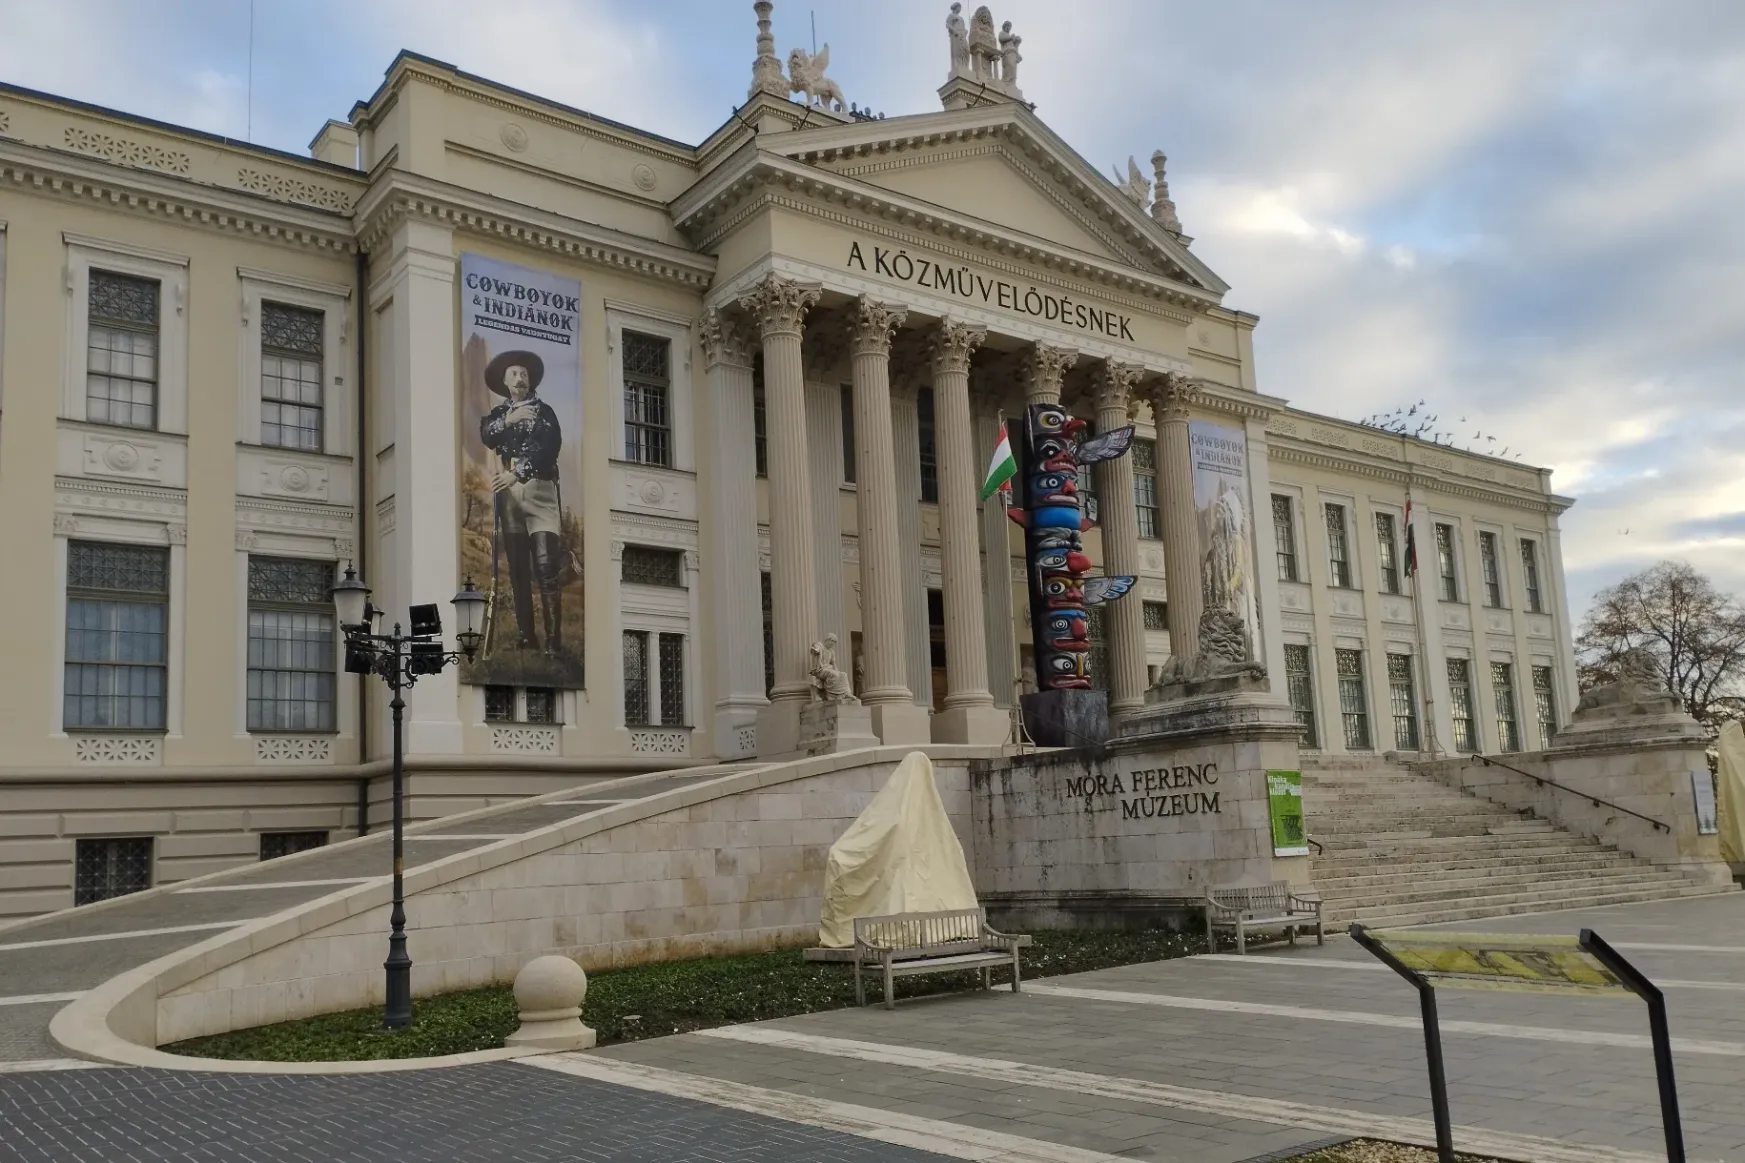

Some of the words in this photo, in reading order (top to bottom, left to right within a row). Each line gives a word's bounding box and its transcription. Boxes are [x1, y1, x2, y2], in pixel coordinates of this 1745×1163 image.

[466, 273, 580, 313] COWBOYOK
[847, 241, 866, 270] A
[874, 246, 1136, 342] KÖZMŰVELŐDÉSNEK
[472, 294, 482, 306] &
[484, 296, 574, 332] INDIÁNOK
[1191, 433, 1245, 455] COWBOYOK
[1066, 771, 1126, 798] MÓRA
[1131, 763, 1219, 793] FERENC
[1121, 791, 1222, 820] MÚZEUM
